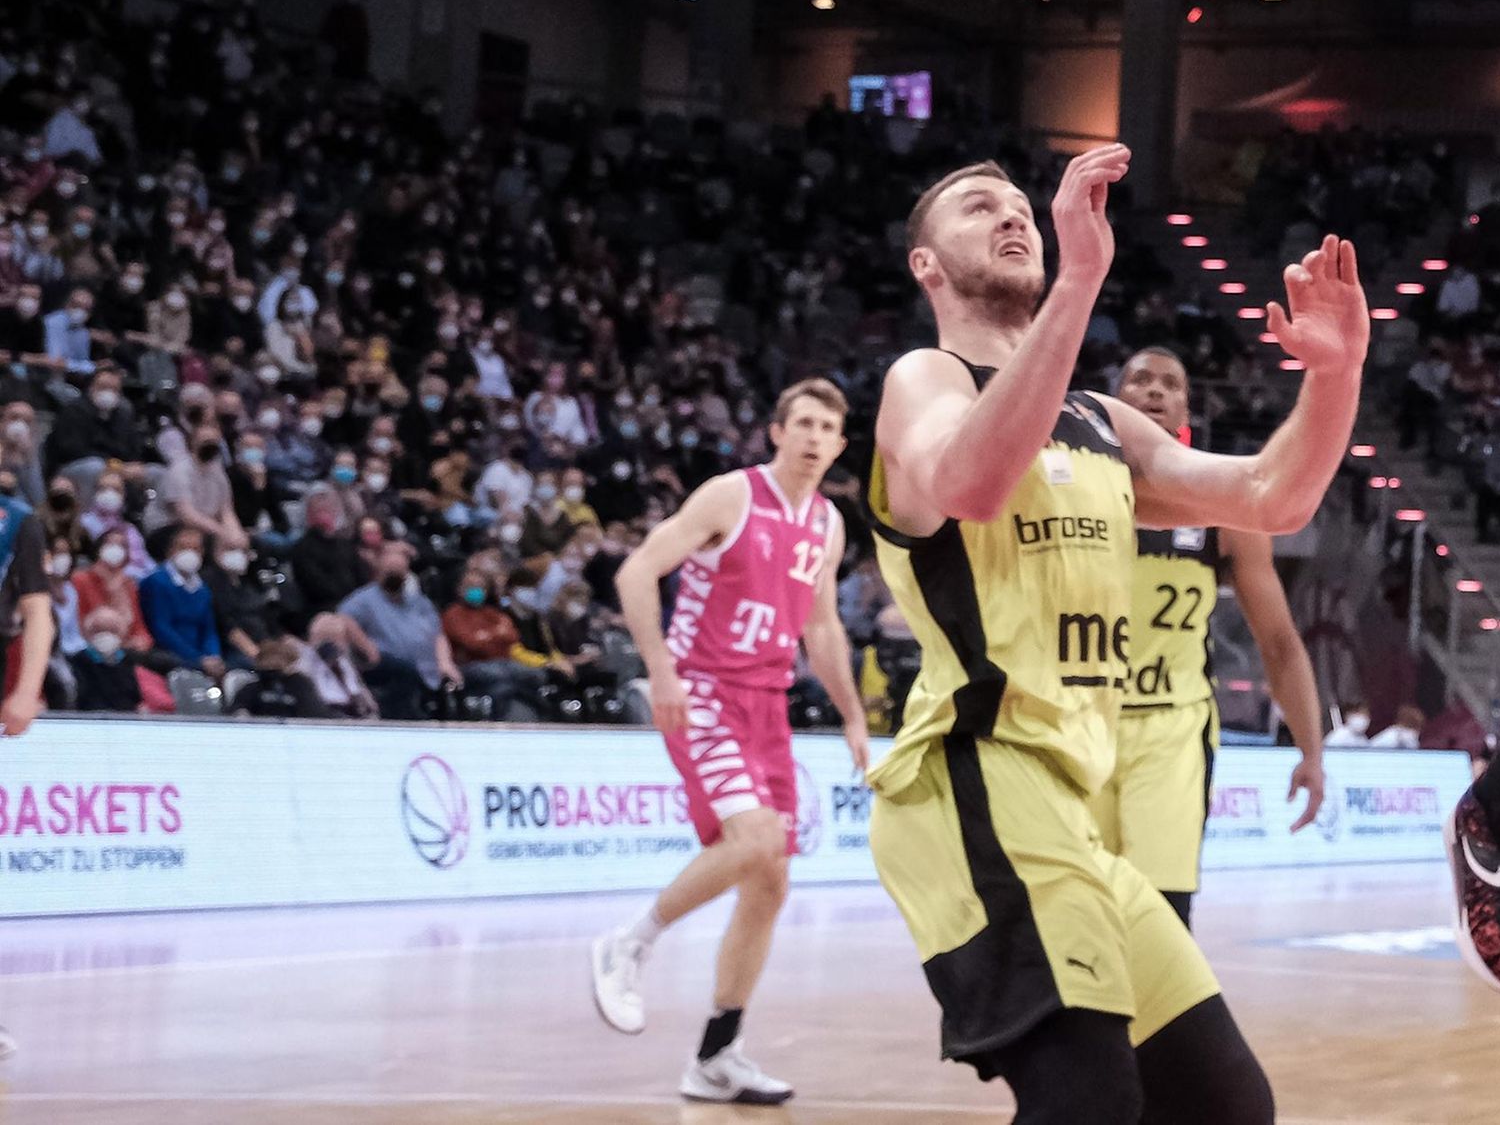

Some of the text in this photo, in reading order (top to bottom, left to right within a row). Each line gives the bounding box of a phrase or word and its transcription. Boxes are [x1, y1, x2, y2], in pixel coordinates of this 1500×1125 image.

[1014, 514, 1110, 545] brose
[788, 540, 824, 586] 12
[1150, 584, 1202, 630] 22
[1058, 613, 1129, 663] me
[484, 784, 690, 828] PROBASKETS
